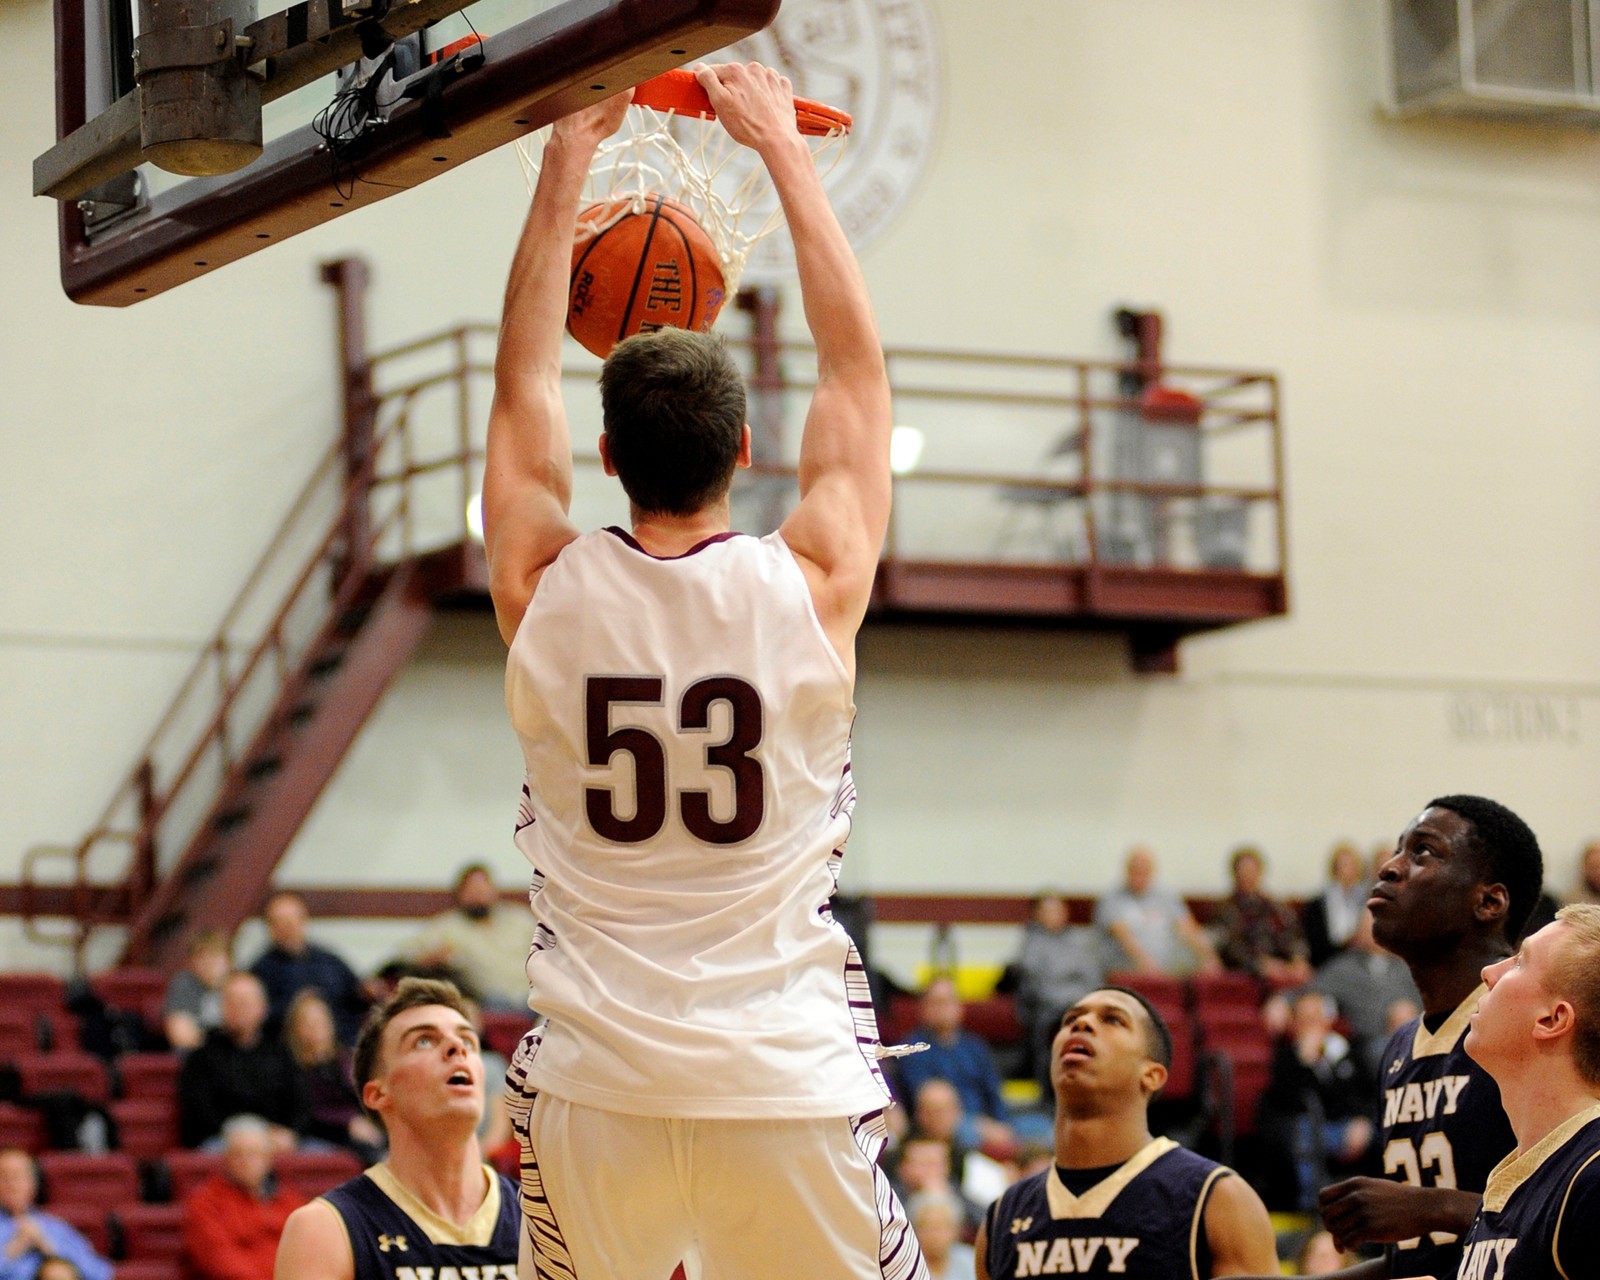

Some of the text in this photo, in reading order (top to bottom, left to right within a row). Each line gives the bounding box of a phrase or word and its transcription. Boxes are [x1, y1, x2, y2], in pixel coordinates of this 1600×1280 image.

[572, 271, 594, 317] ROCK
[645, 259, 681, 311] THE
[582, 674, 767, 849] 53
[1383, 1075, 1470, 1128] NAVY
[1014, 1237, 1139, 1278] NAVY
